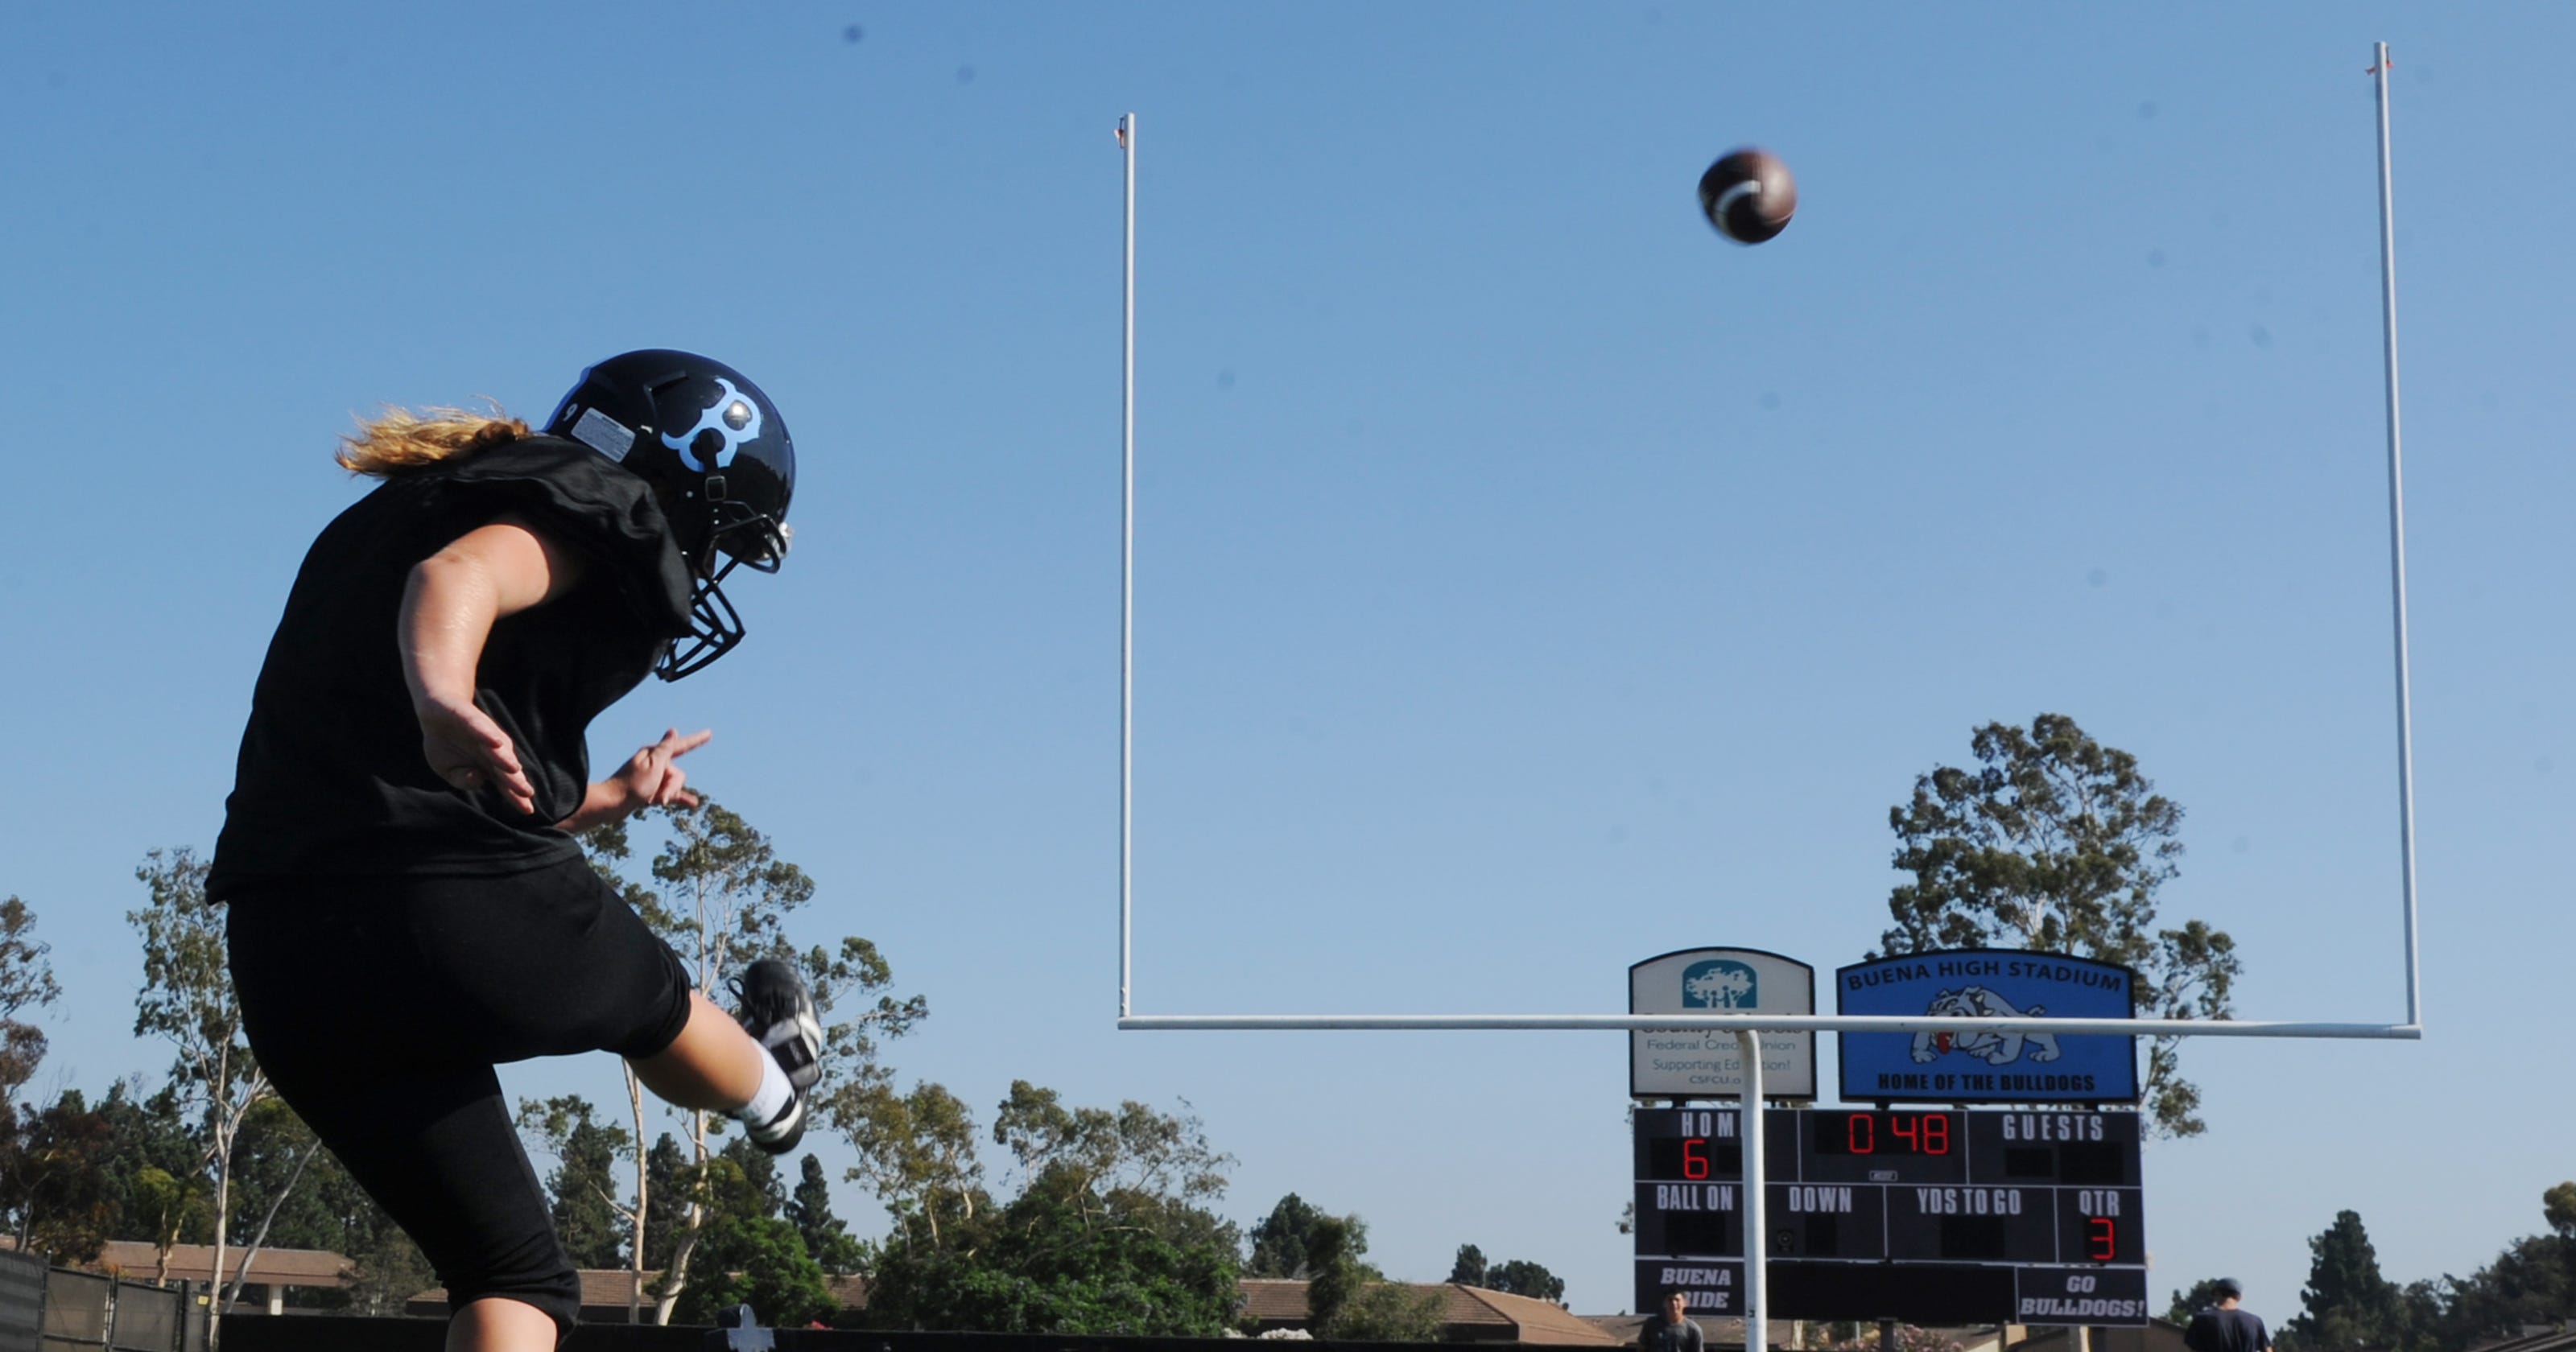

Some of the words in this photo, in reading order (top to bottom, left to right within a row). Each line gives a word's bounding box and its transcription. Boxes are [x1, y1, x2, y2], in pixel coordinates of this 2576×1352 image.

[1847, 964, 1930, 991] BUENA
[1938, 961, 2000, 977] HIGH
[2008, 961, 2122, 992] STADIUM
[1647, 1038, 1700, 1050] Federal
[1704, 1038, 1739, 1050] Cred
[1653, 1058, 1722, 1072] Supporting
[1724, 1058, 1791, 1071] Edtion!
[1878, 1074, 1928, 1090] HOME
[1934, 1074, 1955, 1090] OF
[1961, 1074, 1996, 1090] THE
[2000, 1074, 2095, 1091] BULLDOGS
[1682, 1112, 1742, 1137] HOM
[1892, 1114, 1948, 1155] 48
[2003, 1115, 2103, 1141] GUESTS
[1682, 1139, 1709, 1180] 6
[1657, 1185, 1700, 1210] BALL
[1707, 1185, 1733, 1211] ON
[1789, 1186, 1852, 1213] DOWN
[1918, 1188, 1958, 1214] YDS
[1963, 1188, 1988, 1215] TO
[1993, 1189, 2022, 1215] GO
[2079, 1189, 2120, 1217] QTR
[2090, 1218, 2116, 1260] 3
[1660, 1268, 1732, 1286] BUENA
[2066, 1275, 2096, 1294] GO
[2020, 1297, 2145, 1317] BULLDOGS!
